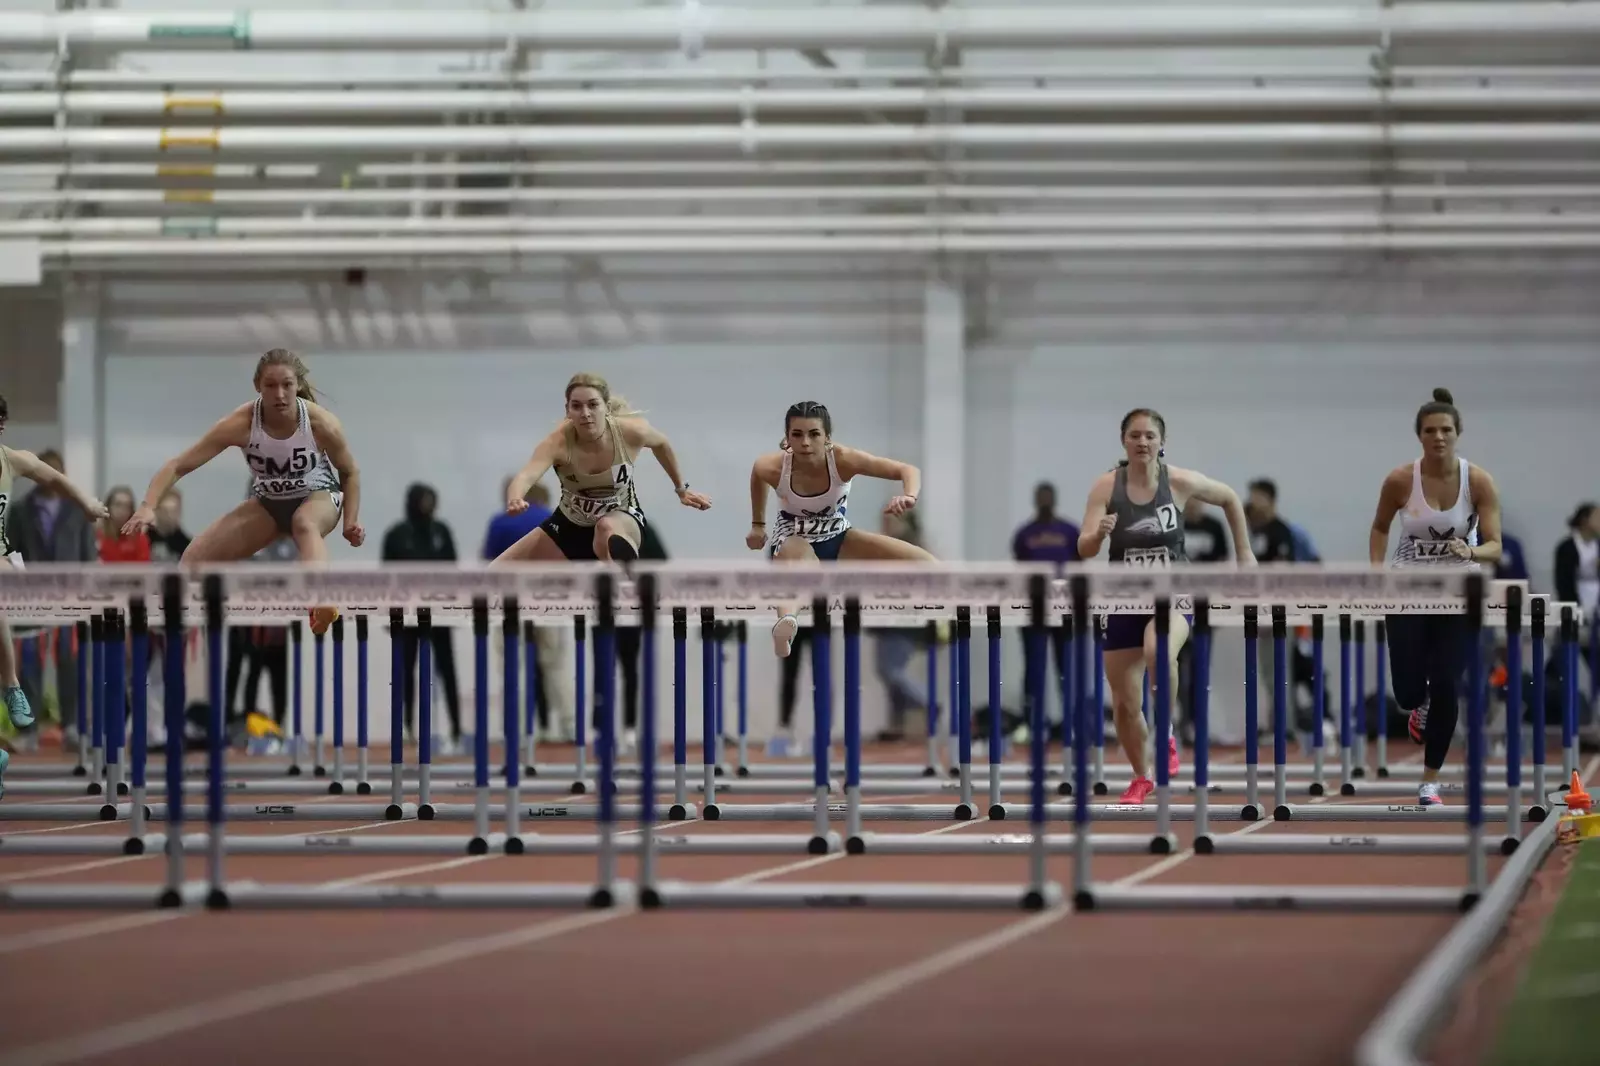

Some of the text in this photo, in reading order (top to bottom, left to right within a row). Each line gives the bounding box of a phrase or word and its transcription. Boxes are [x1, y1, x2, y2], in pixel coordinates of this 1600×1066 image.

[292, 447, 308, 470] 5
[616, 463, 629, 485] 4
[1161, 506, 1175, 530] 2
[1417, 542, 1450, 556] 122
[255, 805, 295, 815] UCS
[528, 807, 567, 817] UCS
